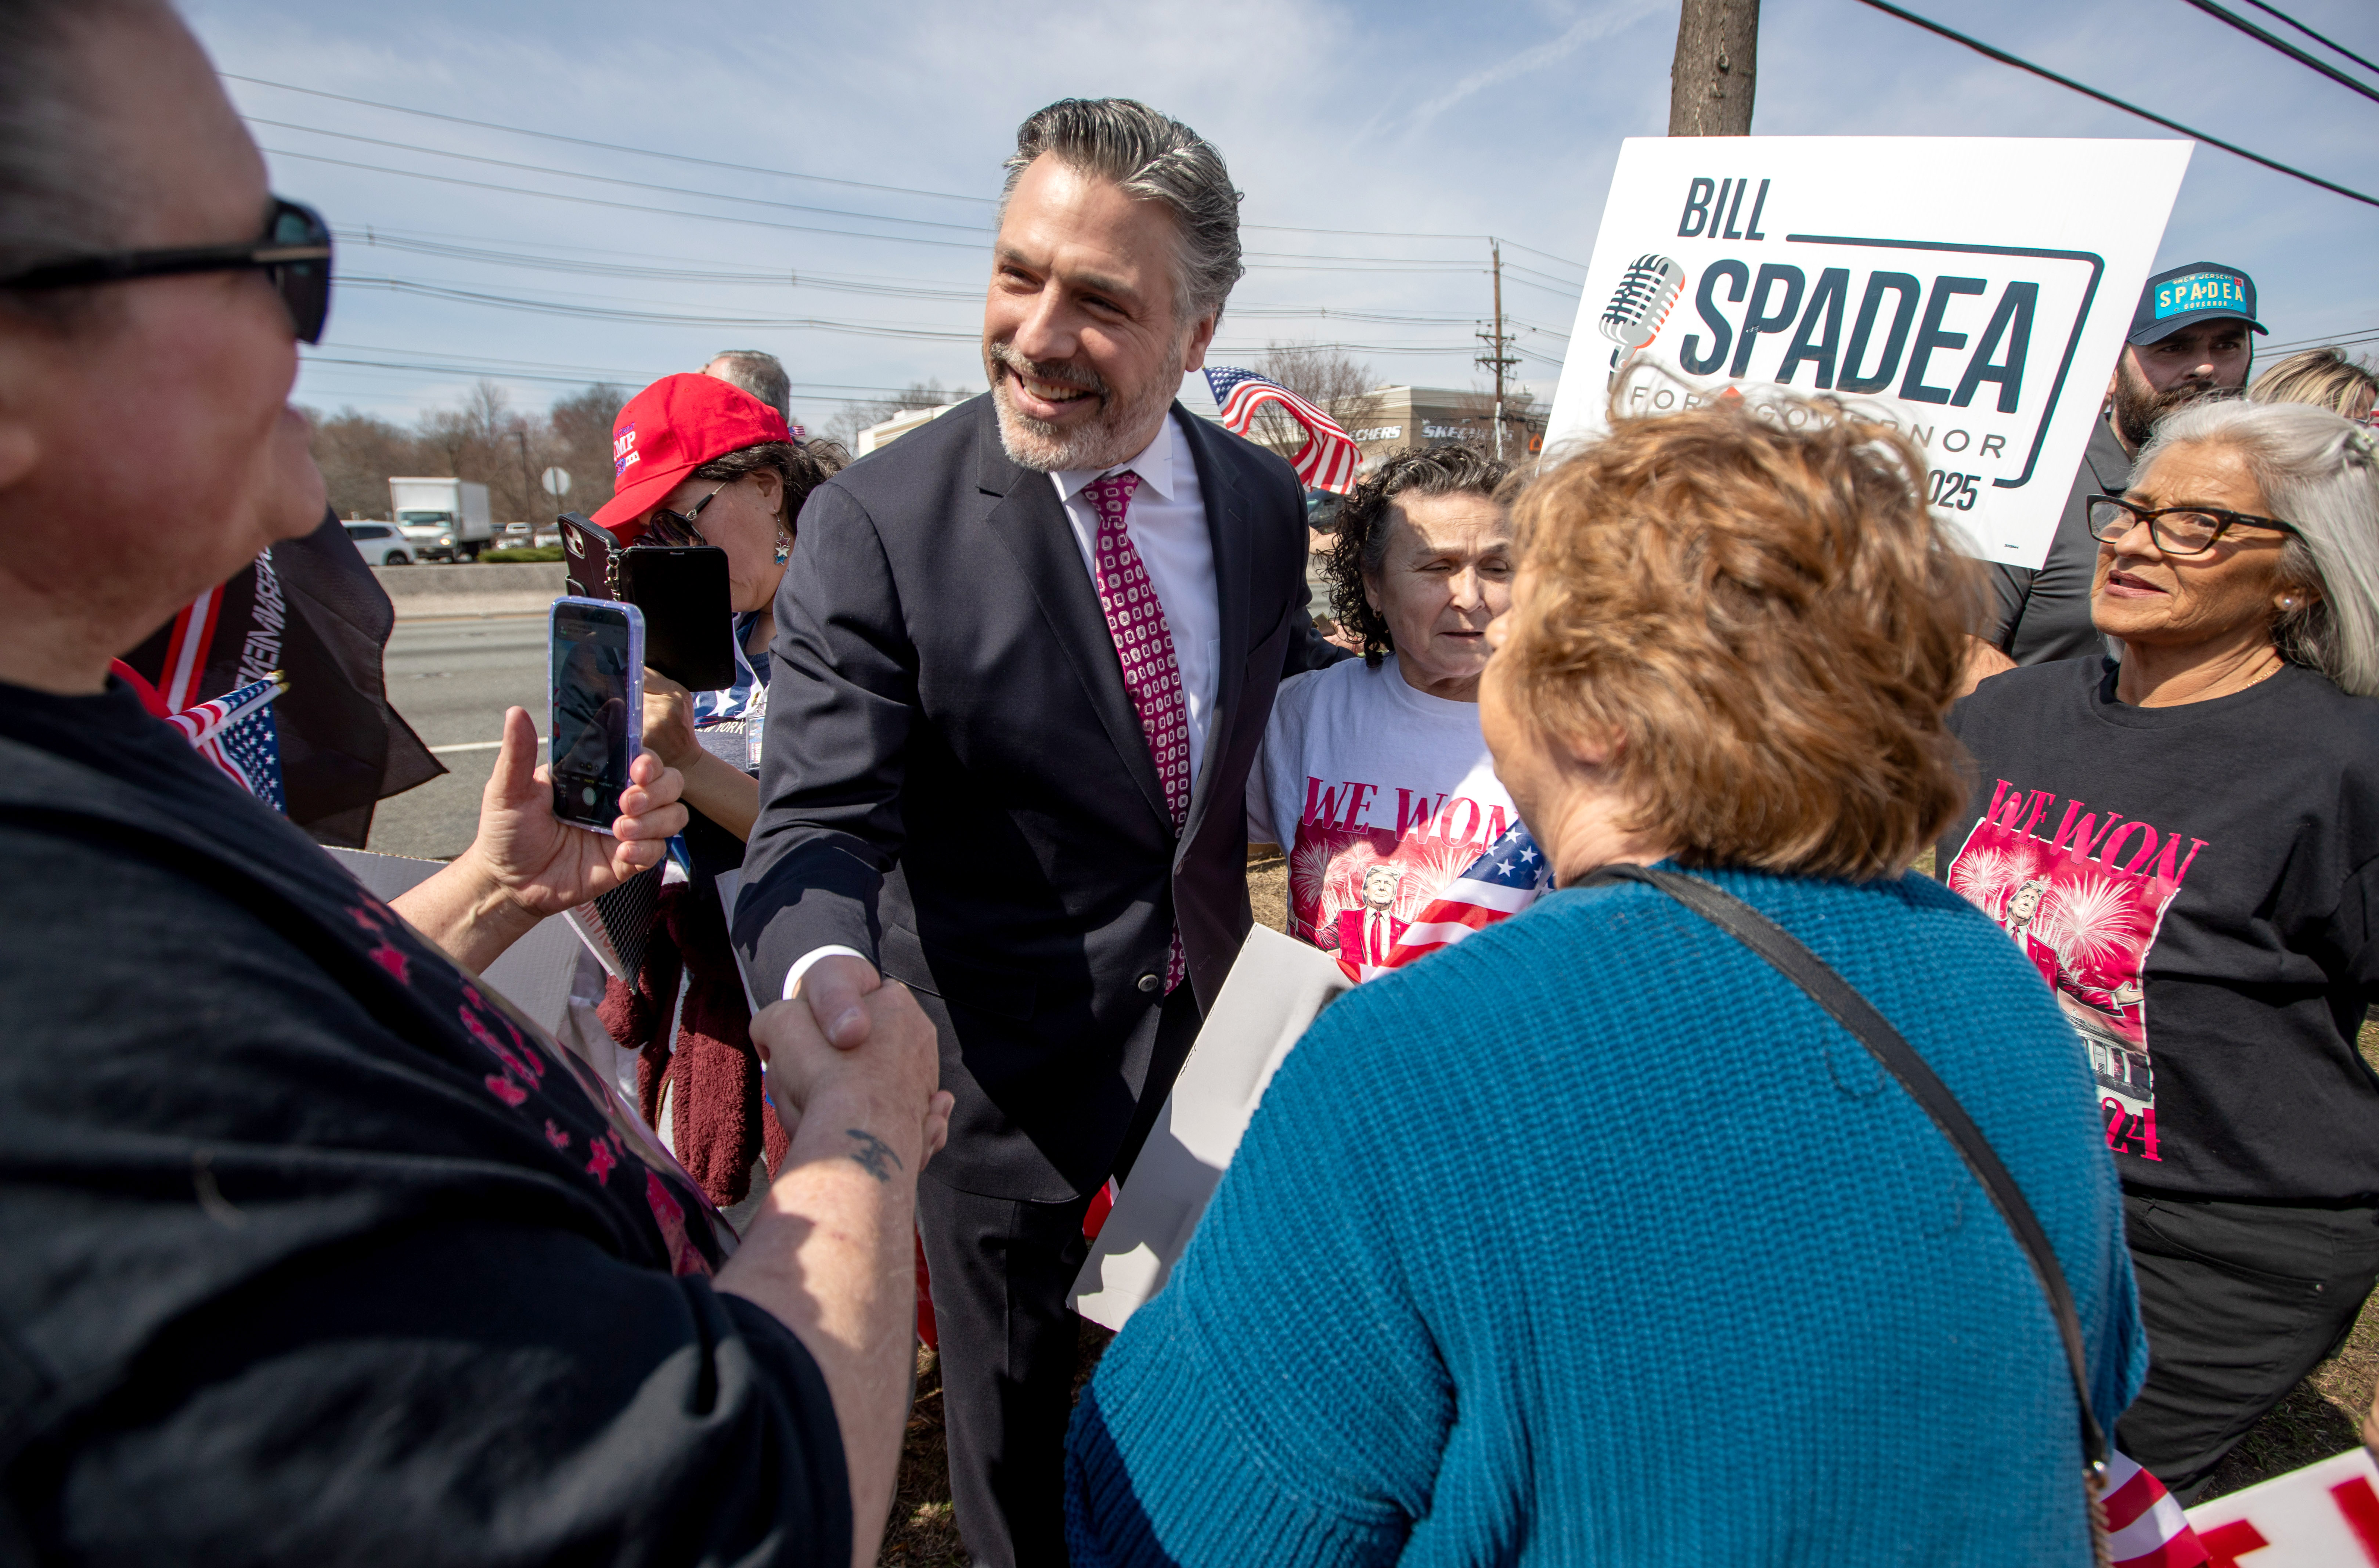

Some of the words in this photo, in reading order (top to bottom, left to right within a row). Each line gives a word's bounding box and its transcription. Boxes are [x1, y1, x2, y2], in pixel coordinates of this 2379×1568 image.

[1677, 177, 1771, 241] BILL
[2160, 281, 2243, 308] SPADEA
[2184, 301, 2227, 310] GOVERNOR
[1680, 258, 2039, 414] SPADEA
[1926, 469, 1981, 511] 025
[715, 721, 746, 734] YORK
[1302, 776, 1378, 835] WE
[1983, 778, 2056, 848] WE
[2049, 799, 2210, 897] WON
[2102, 1097, 2162, 1161] 24
